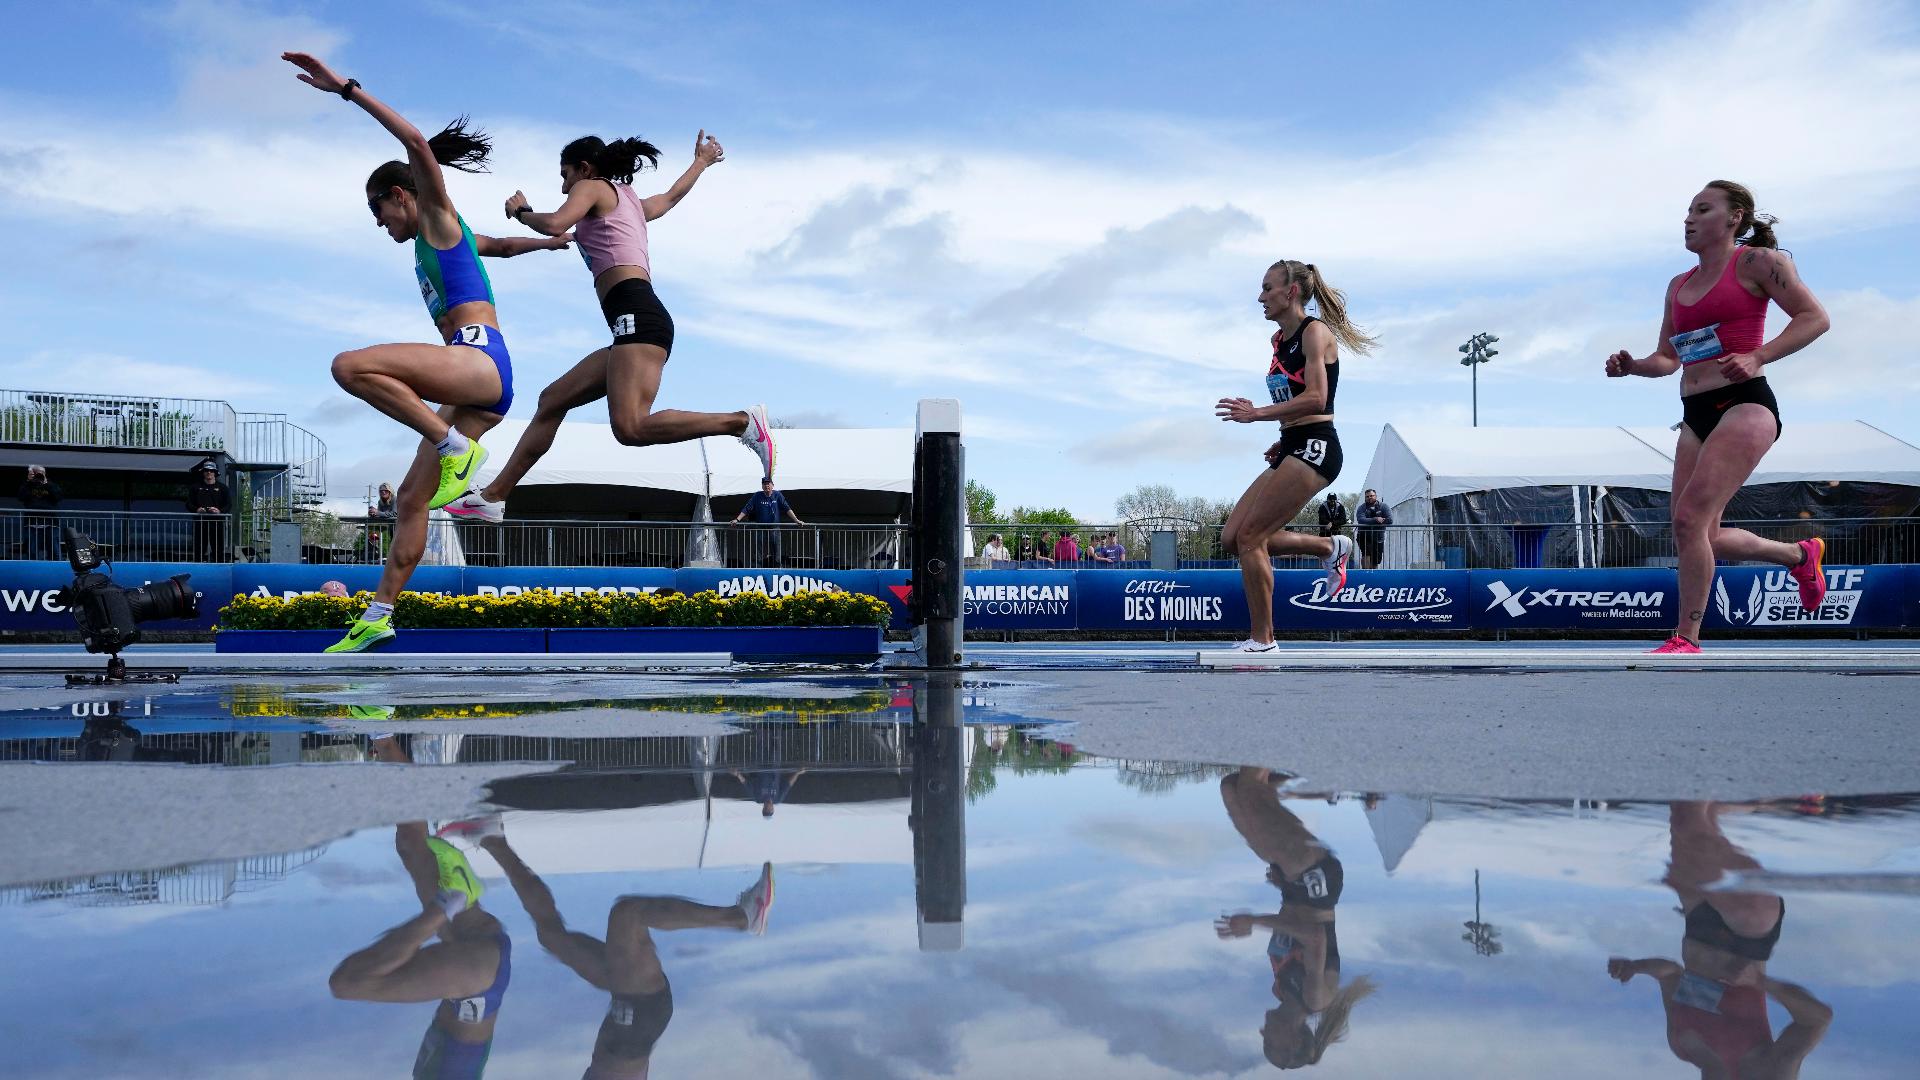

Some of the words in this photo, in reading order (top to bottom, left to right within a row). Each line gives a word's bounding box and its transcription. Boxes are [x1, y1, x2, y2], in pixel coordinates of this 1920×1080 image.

[465, 325, 481, 343] 7
[1308, 439, 1322, 461] 9
[718, 575, 767, 597] PAPA
[1124, 579, 1191, 594] CATCH
[1764, 568, 1865, 592] USTF
[963, 585, 1069, 601] AMERICAN
[1385, 587, 1447, 603] RELAYS
[1525, 588, 1665, 607] XTREAM
[986, 601, 1069, 615] COMPANY
[1124, 596, 1155, 621] DES
[1160, 596, 1223, 621] MOINES
[1609, 608, 1661, 618] Mediacom
[1767, 604, 1851, 622] SERIES
